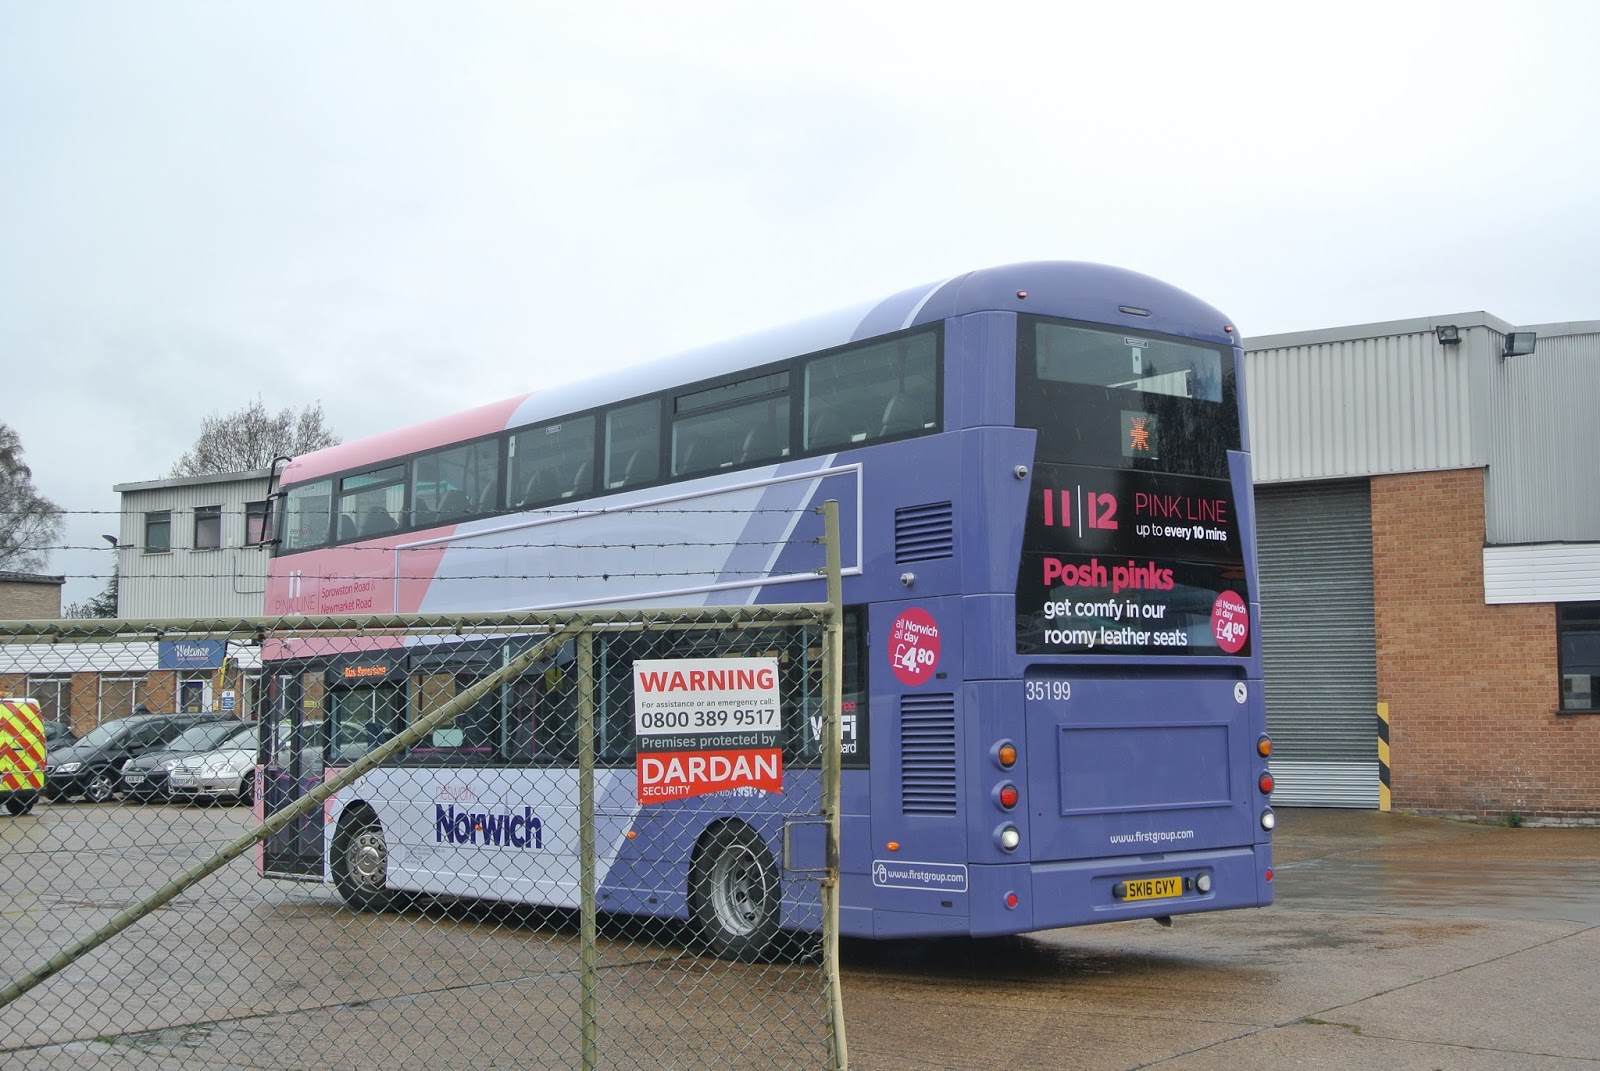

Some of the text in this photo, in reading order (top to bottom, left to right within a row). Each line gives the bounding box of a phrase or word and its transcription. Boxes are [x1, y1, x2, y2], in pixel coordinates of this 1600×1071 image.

[1044, 489, 1118, 530] 11 12
[1135, 492, 1227, 523] PINK LINE
[1136, 523, 1227, 541] up to every 10 mins
[1043, 557, 1174, 594] Posh pinks
[321, 584, 354, 600] Sprowston
[354, 581, 370, 593] Road
[275, 594, 316, 615] PINK LINE
[321, 597, 373, 615] Newmarket Road
[1043, 599, 1166, 621] get comfy in our
[1215, 599, 1246, 614] all Norwich
[1222, 609, 1233, 621] day
[894, 629, 919, 645] all day
[895, 618, 938, 637] all Norwich
[1044, 626, 1188, 648] roomy leather seats
[640, 669, 774, 693] WARNING
[1026, 681, 1071, 700] 35199
[656, 700, 695, 708] assistance
[717, 699, 758, 708] emergency
[641, 709, 775, 728] 0800 389 9517
[641, 733, 776, 749] Premises protected by
[642, 754, 778, 784] DARDAN
[642, 785, 691, 796] SECURITY
[436, 804, 542, 849] Norwich
[1110, 830, 1194, 844] www.firstgroup.com
[888, 870, 964, 884] www.firstgroup.com
[1129, 880, 1175, 897] SK16 GVY
